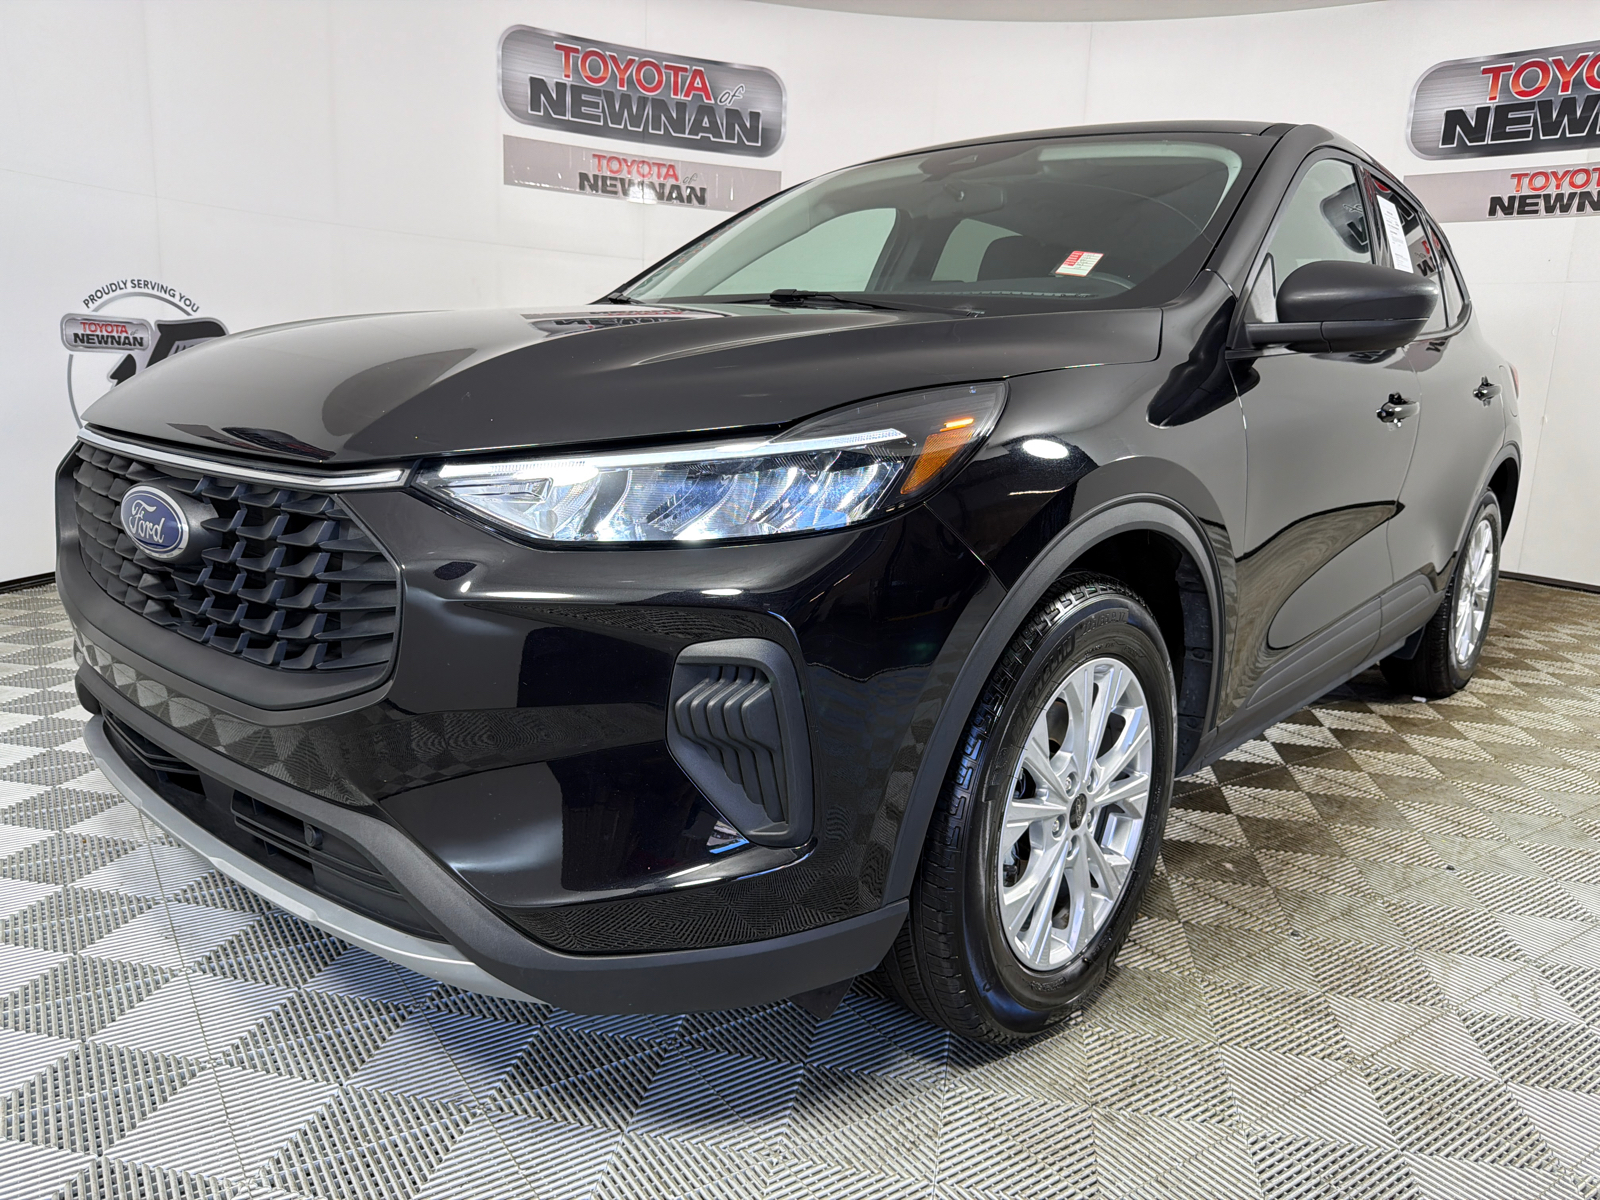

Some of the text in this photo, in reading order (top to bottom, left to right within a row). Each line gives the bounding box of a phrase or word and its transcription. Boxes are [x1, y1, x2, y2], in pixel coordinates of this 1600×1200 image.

[553, 41, 745, 106] TOYOTA of
[528, 76, 762, 146] NEWNAN
[1439, 92, 1600, 148] NEW
[592, 153, 698, 184] TOYOTA of
[83, 279, 200, 313] PROUDLY SERVING YOU
[73, 332, 144, 348] NEWNAN
[80, 321, 129, 335] TOYOTA
[128, 500, 166, 543] Ford
